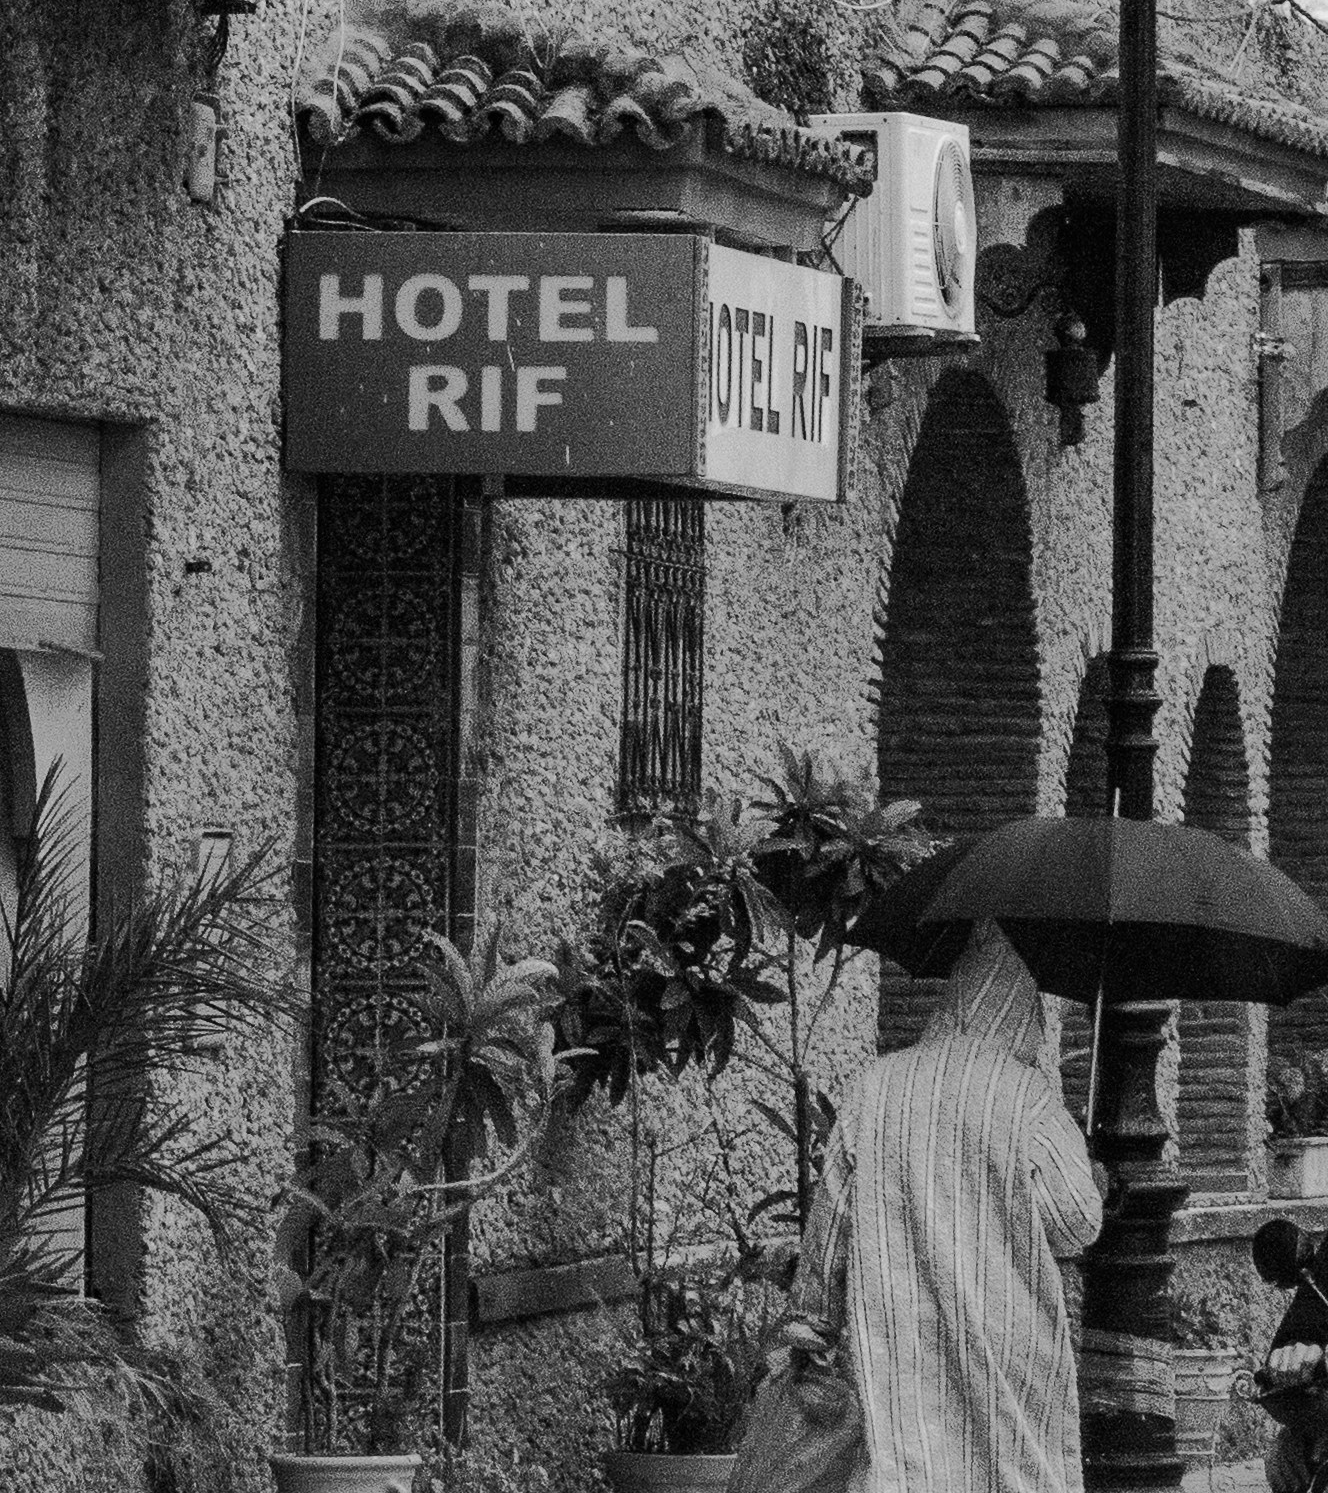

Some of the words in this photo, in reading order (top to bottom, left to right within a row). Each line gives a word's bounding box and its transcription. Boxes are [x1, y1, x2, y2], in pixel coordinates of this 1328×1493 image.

[317, 273, 660, 344] HOTEL
[407, 364, 568, 433] RIF
[792, 320, 833, 443] RIF
